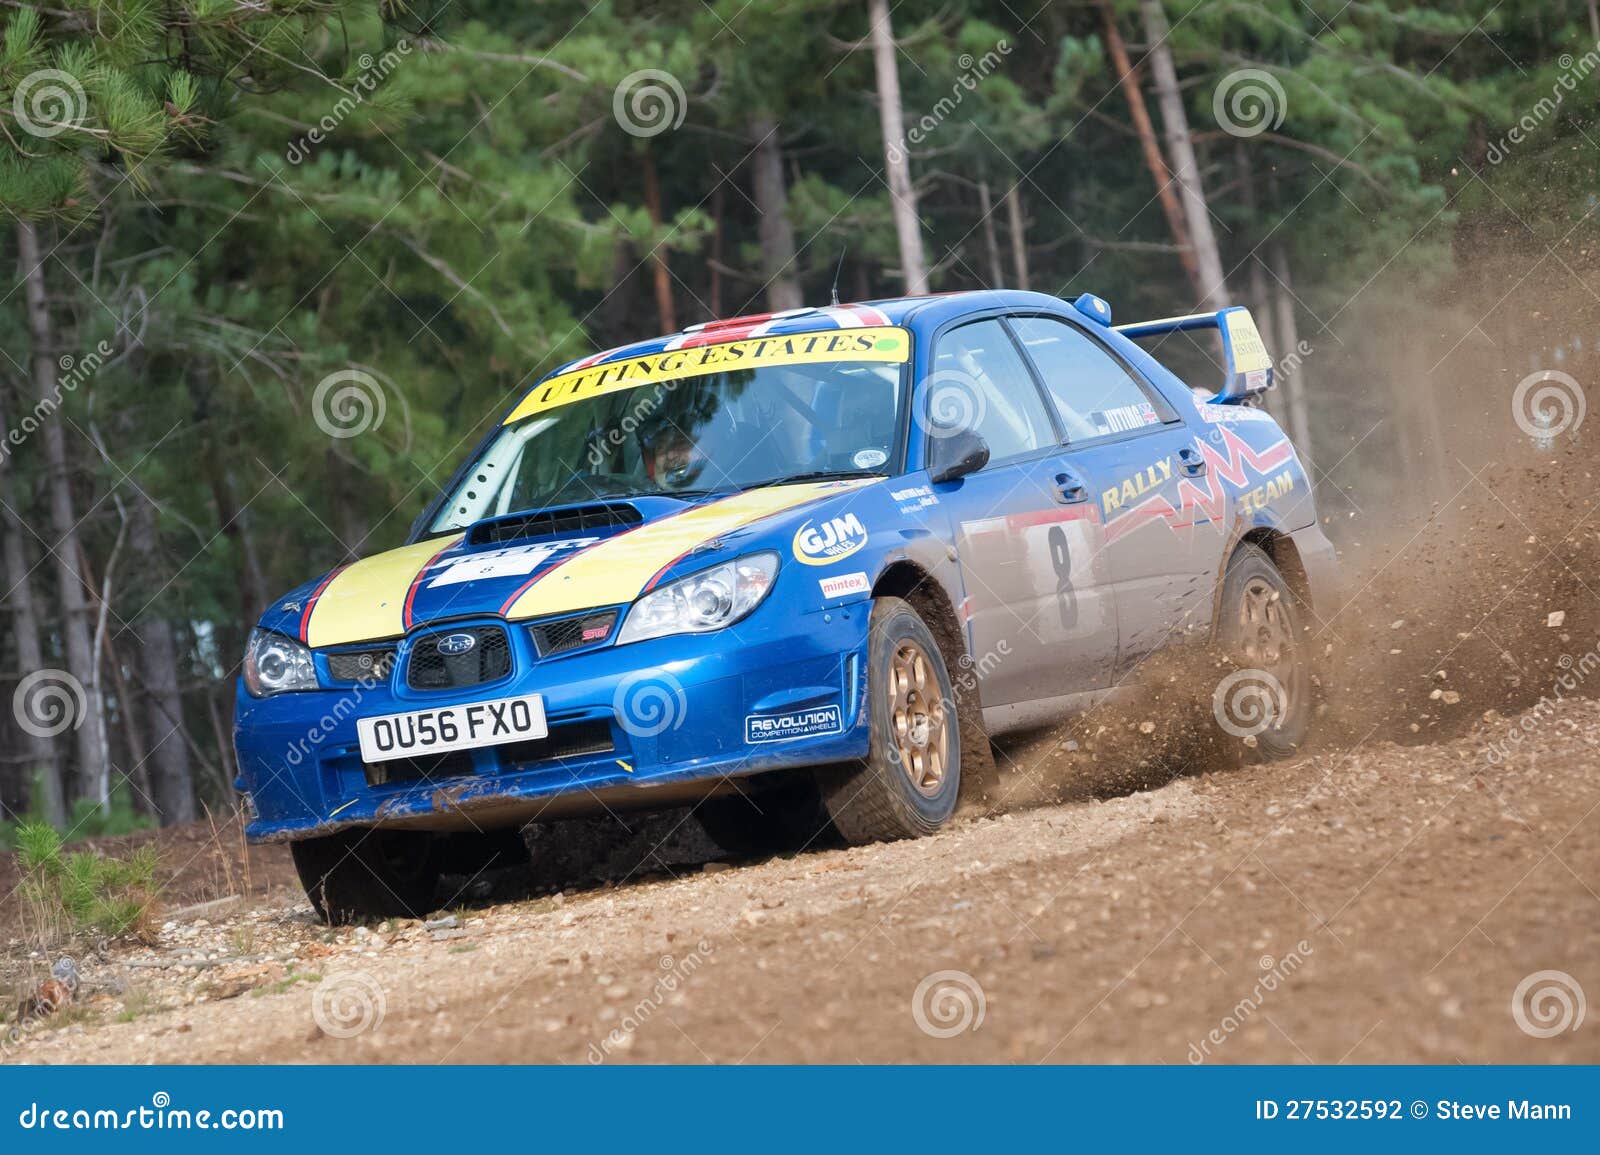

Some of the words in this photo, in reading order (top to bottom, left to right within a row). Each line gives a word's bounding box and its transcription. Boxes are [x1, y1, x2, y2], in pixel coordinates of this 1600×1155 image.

[540, 352, 688, 403] UTTING
[698, 334, 877, 366] ESTATES
[1102, 456, 1172, 515] RALLY
[1239, 470, 1294, 516] TEAM
[799, 512, 865, 554] GJM
[822, 541, 857, 557] WALES
[823, 574, 862, 593] mintex
[1047, 525, 1079, 630] 8
[374, 710, 459, 752] OU56
[466, 700, 532, 739] FXO
[751, 710, 836, 731] REVOLUTION
[751, 728, 804, 739] COMPETITION
[808, 721, 837, 732] WHEELS
